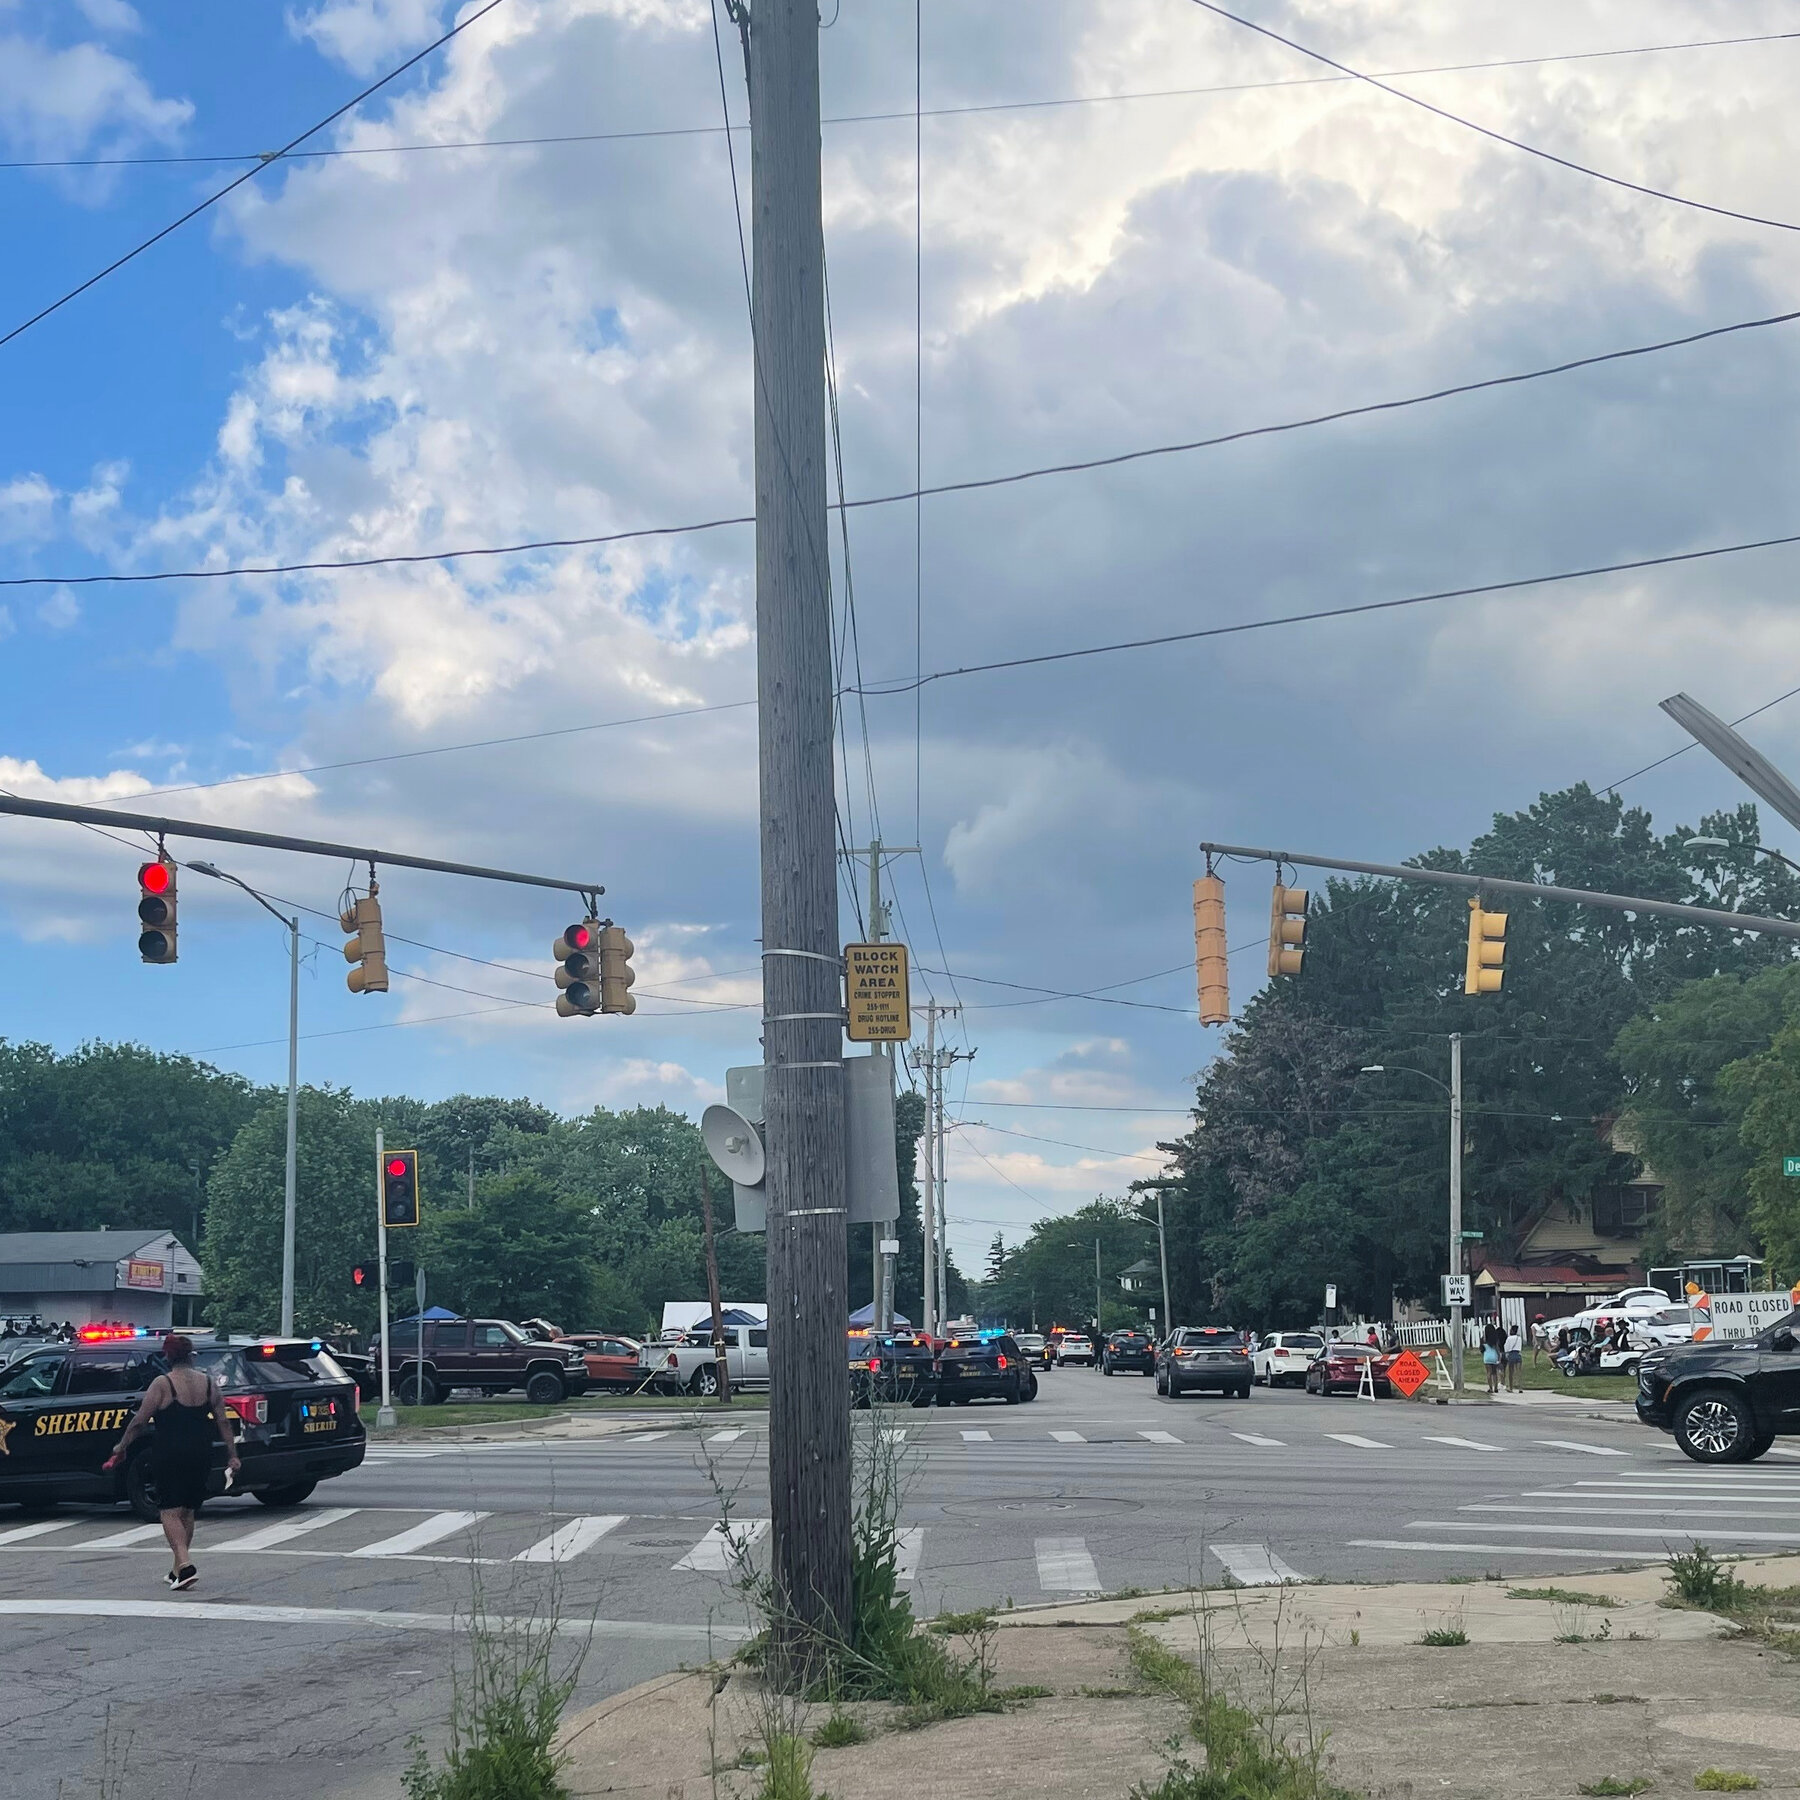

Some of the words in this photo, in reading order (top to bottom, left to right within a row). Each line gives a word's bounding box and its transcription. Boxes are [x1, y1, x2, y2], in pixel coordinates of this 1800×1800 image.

[853, 951, 898, 961] BLOCK
[854, 965, 899, 974] WATCH
[860, 978, 896, 987] AREA
[854, 991, 871, 999] CRIME
[857, 1015, 874, 1023] DRUG
[875, 1014, 899, 1022] HOTLINE
[868, 1026, 896, 1034] 255-DRUG
[1449, 1276, 1465, 1285] ONE
[1449, 1287, 1465, 1295] WAY
[1714, 1301, 1743, 1314] ROAD
[1749, 1299, 1789, 1312] CLOSED
[1747, 1314, 1759, 1325] TO
[1723, 1327, 1746, 1339] THRU
[34, 1408, 129, 1437] SHERIFF
